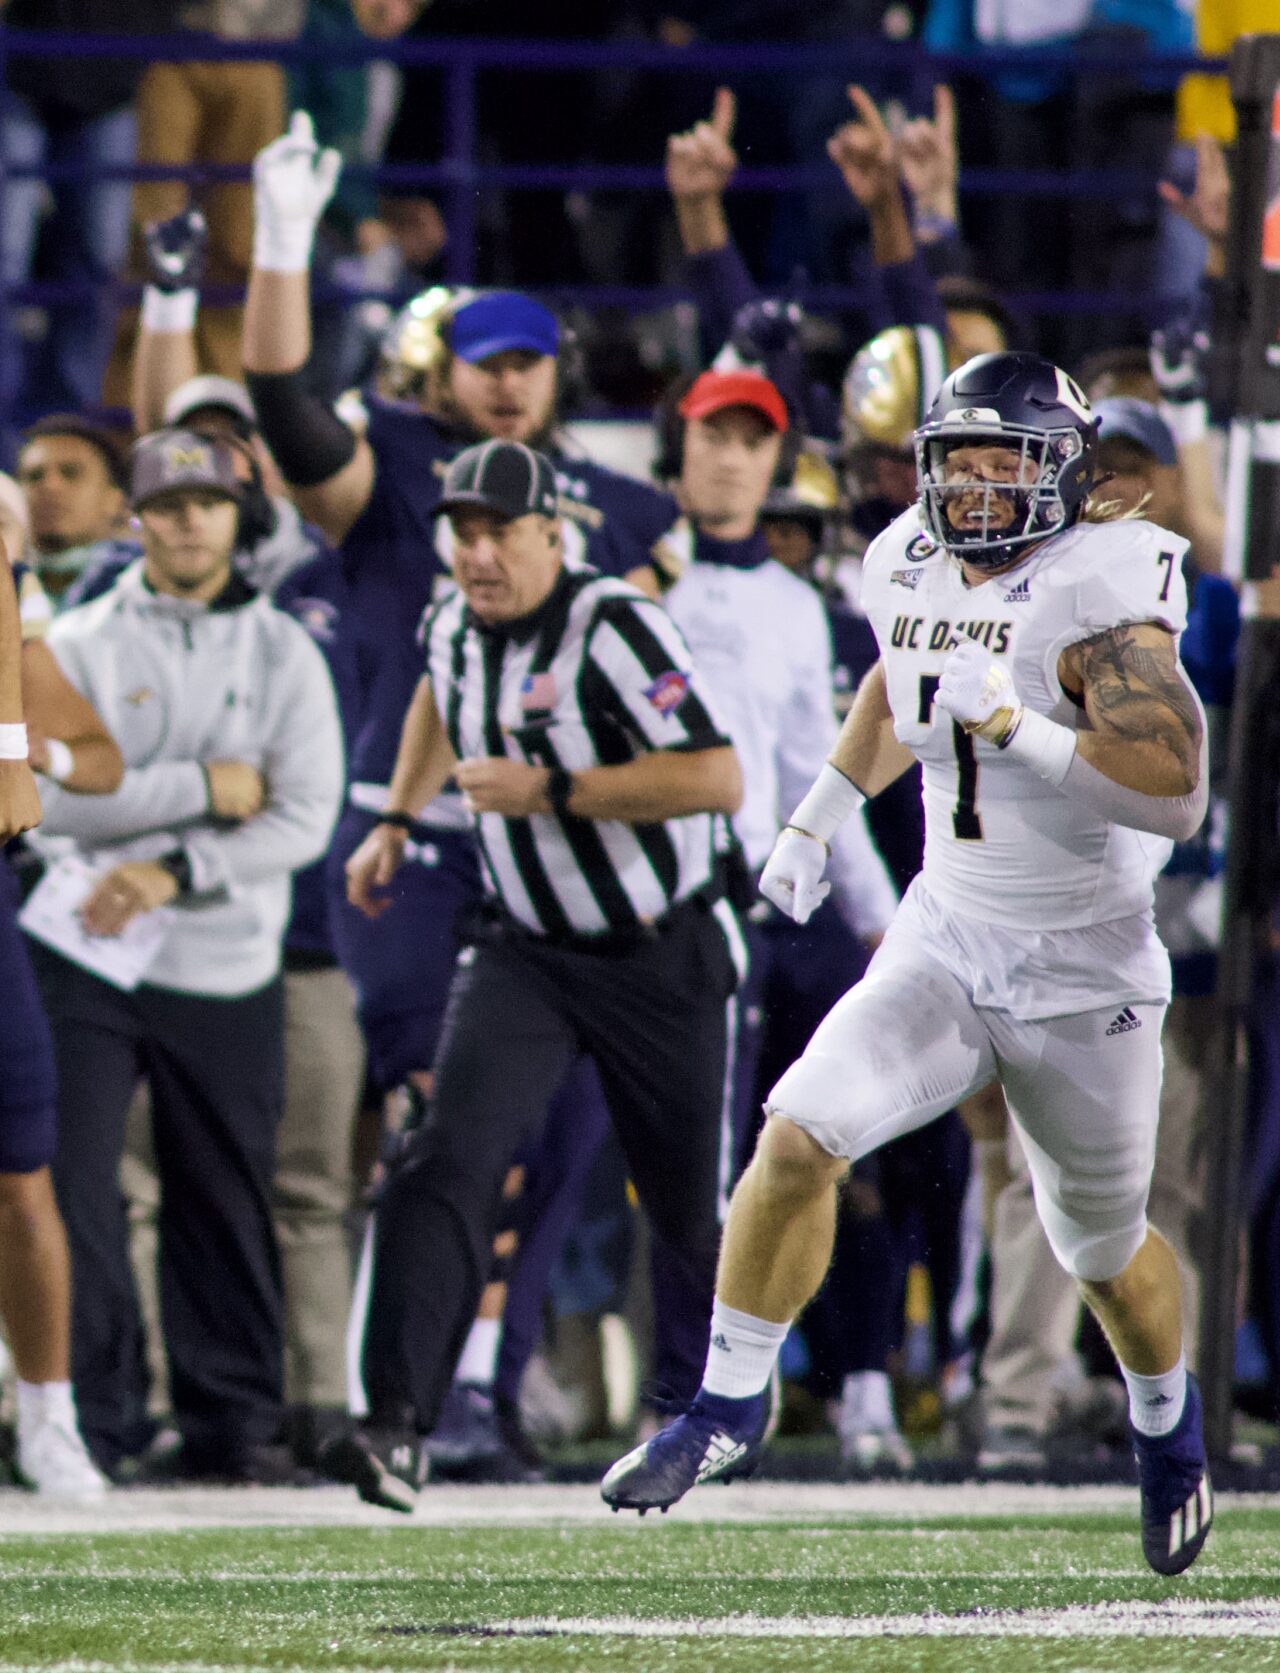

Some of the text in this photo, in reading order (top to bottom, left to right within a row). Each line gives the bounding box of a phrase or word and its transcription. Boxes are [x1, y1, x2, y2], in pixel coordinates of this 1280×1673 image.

[1156, 550, 1176, 603] 7
[890, 613, 926, 650] UC
[1105, 1019, 1142, 1036] adidas
